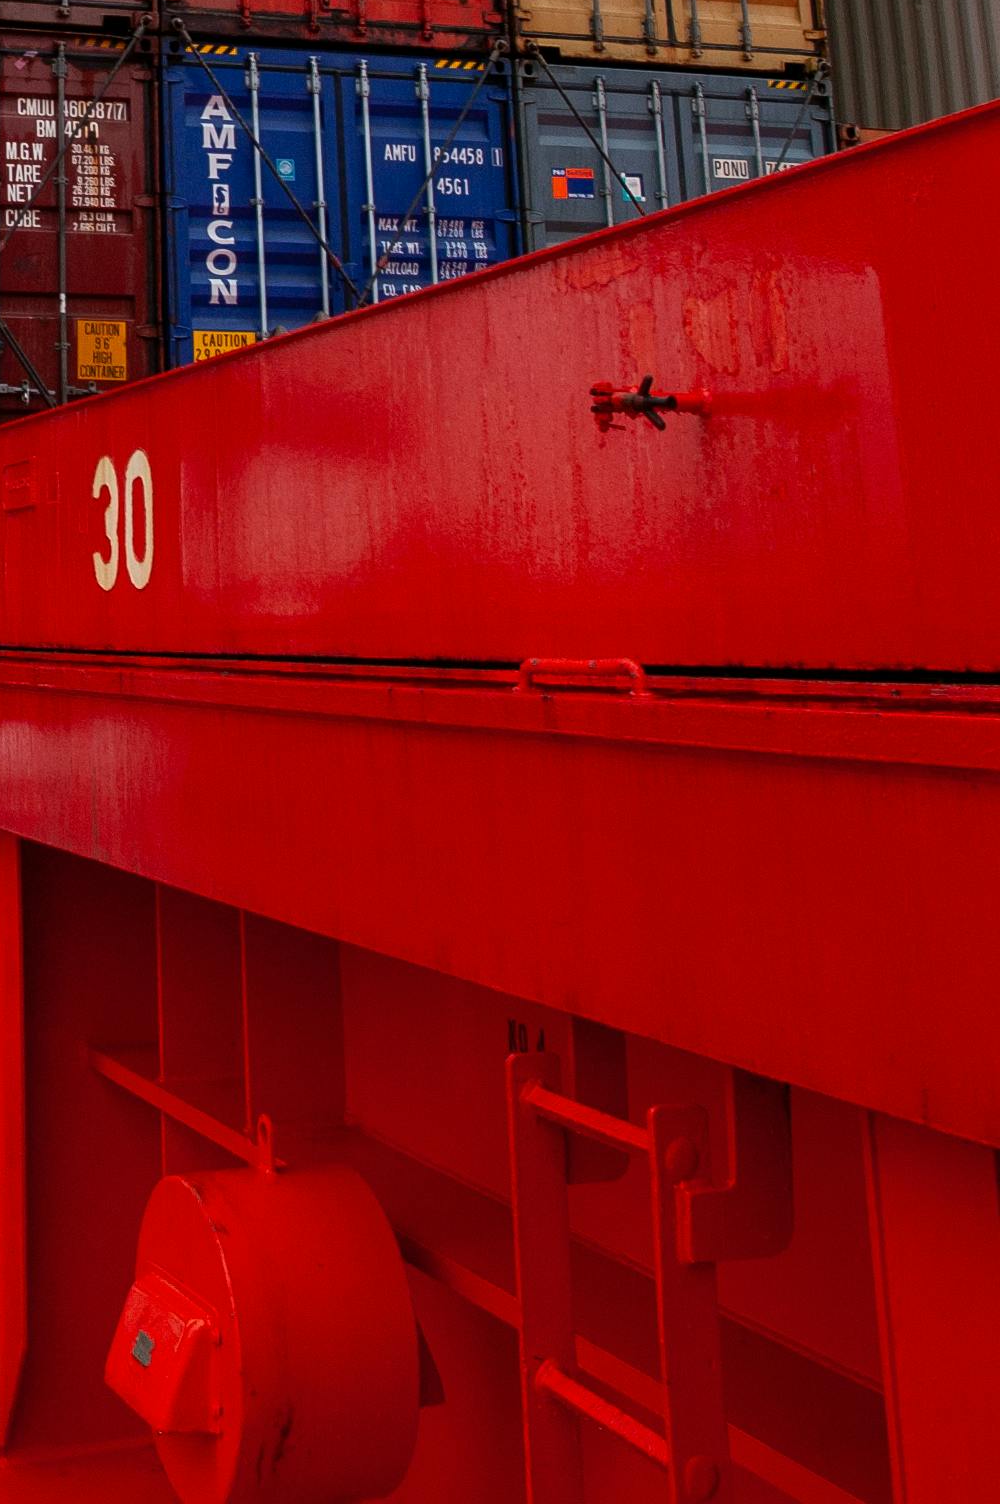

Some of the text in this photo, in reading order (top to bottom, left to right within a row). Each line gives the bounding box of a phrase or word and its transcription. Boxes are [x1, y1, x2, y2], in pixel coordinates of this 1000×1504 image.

[17, 98, 55, 117] CMUU
[36, 120, 56, 138] BM
[5, 142, 47, 161] M.G.W.
[384, 144, 416, 162] AMFU
[6, 164, 41, 183] TARE
[714, 161, 747, 176] PONU
[7, 184, 34, 202] NET
[437, 178, 469, 195] 45G1
[378, 218, 398, 232] MAX
[84, 322, 120, 337] CAUTION
[202, 333, 247, 346] CAUTION
[93, 351, 112, 364] HIGH
[79, 364, 126, 379] CONTAINER
[92, 449, 153, 591] 30
